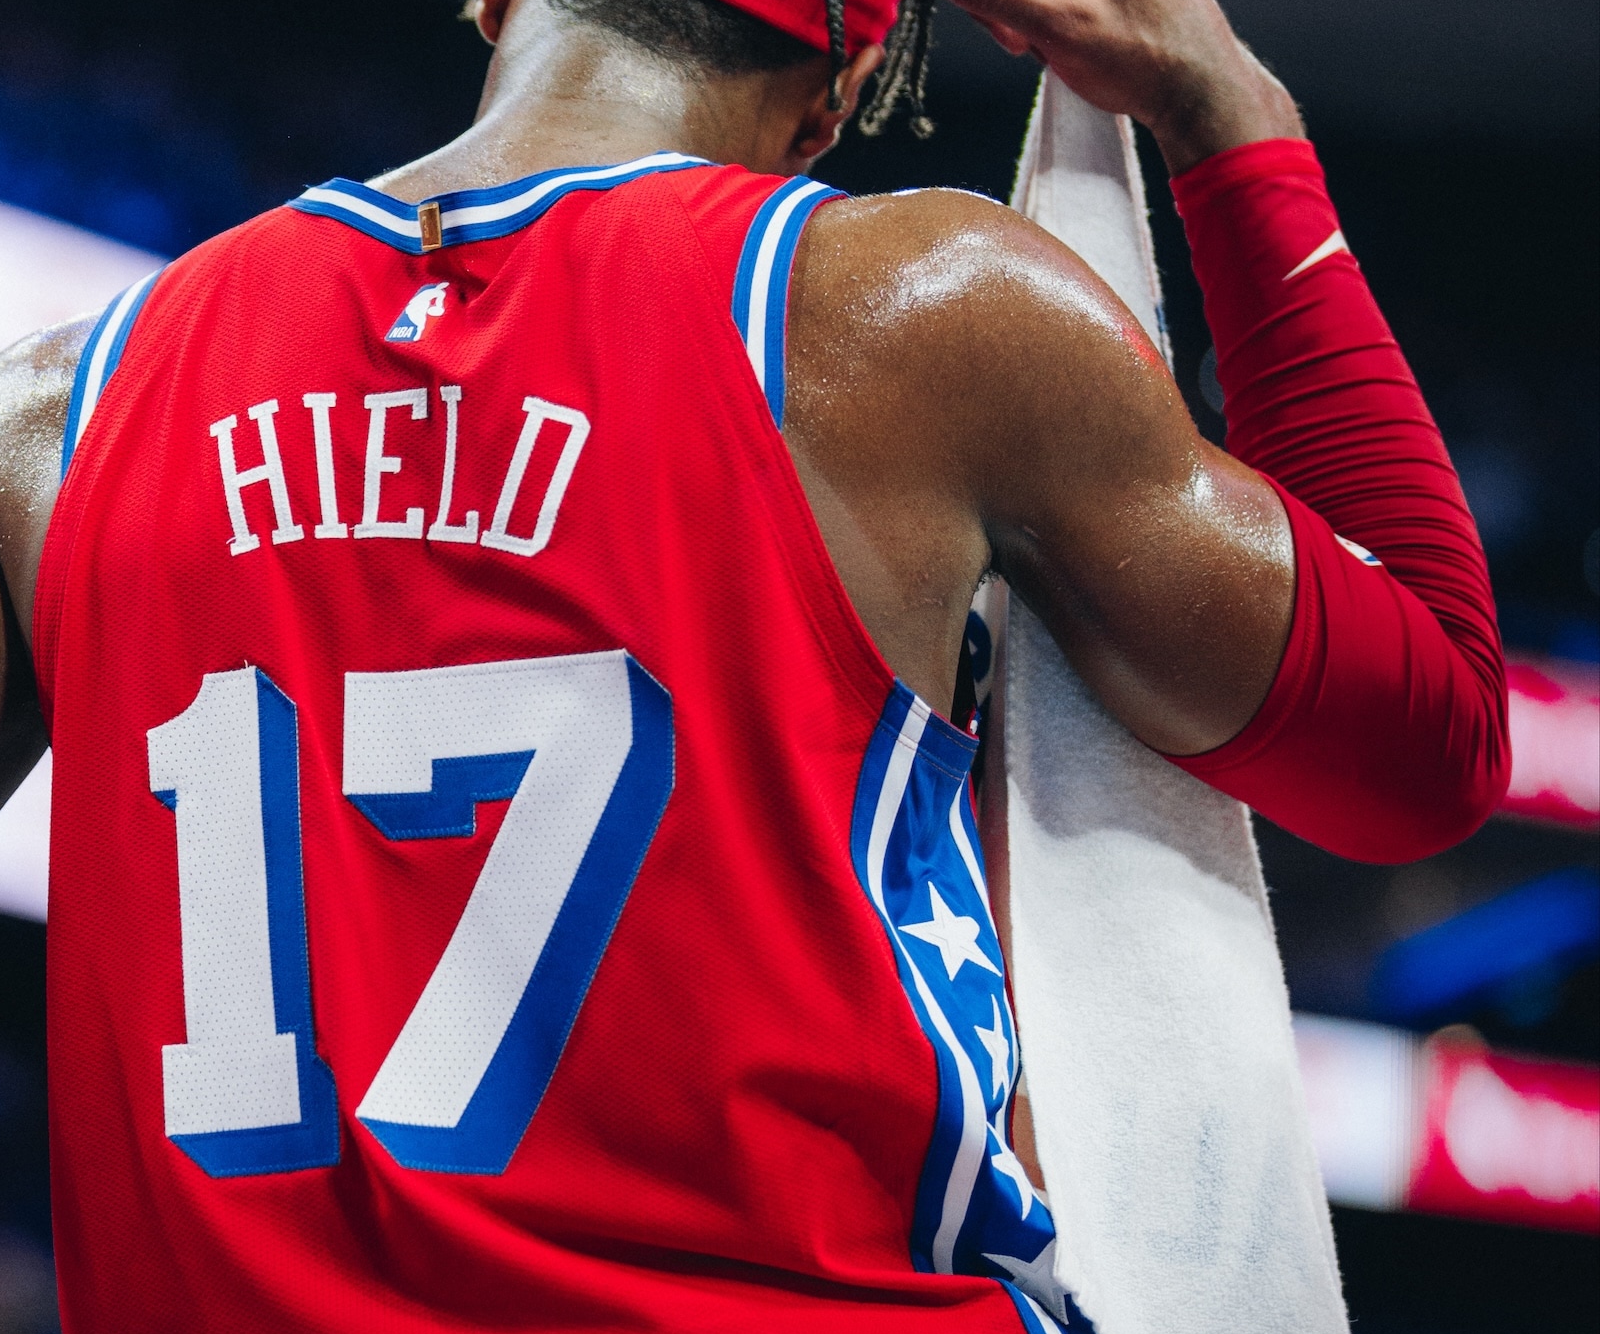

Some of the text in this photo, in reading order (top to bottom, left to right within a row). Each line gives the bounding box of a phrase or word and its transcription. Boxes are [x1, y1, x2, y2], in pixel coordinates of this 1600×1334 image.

[388, 326, 415, 339] NBA
[210, 384, 592, 557] HIELD
[146, 650, 675, 1177] 17
